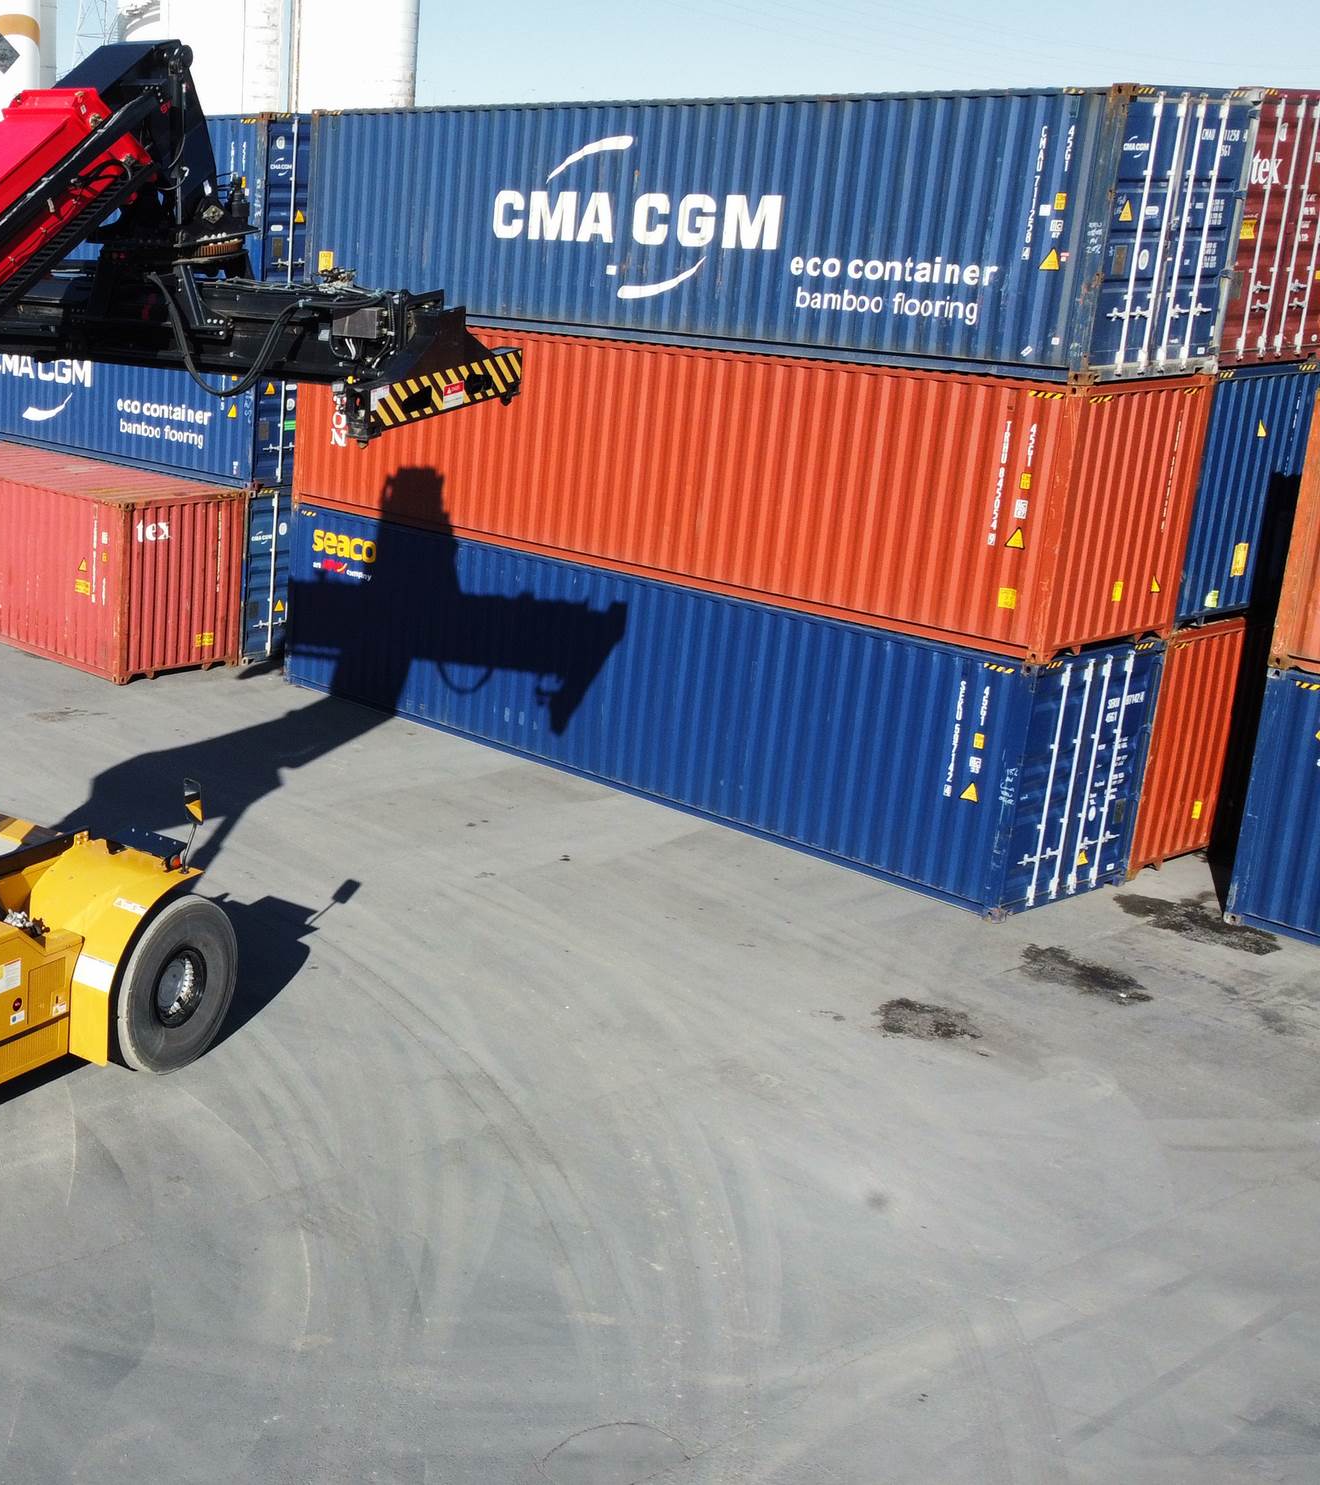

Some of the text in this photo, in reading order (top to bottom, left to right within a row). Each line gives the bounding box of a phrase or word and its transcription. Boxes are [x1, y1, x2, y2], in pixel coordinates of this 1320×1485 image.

[1064, 125, 1076, 172] 45G1
[492, 190, 783, 250] CMA CGM
[790, 256, 998, 287] eco container
[795, 286, 980, 326] bamboo flooring
[37, 359, 93, 388] CGM
[117, 398, 212, 426] eco container
[120, 419, 204, 450] bamboo flooring
[136, 519, 170, 543] tex
[312, 529, 377, 564] seaco
